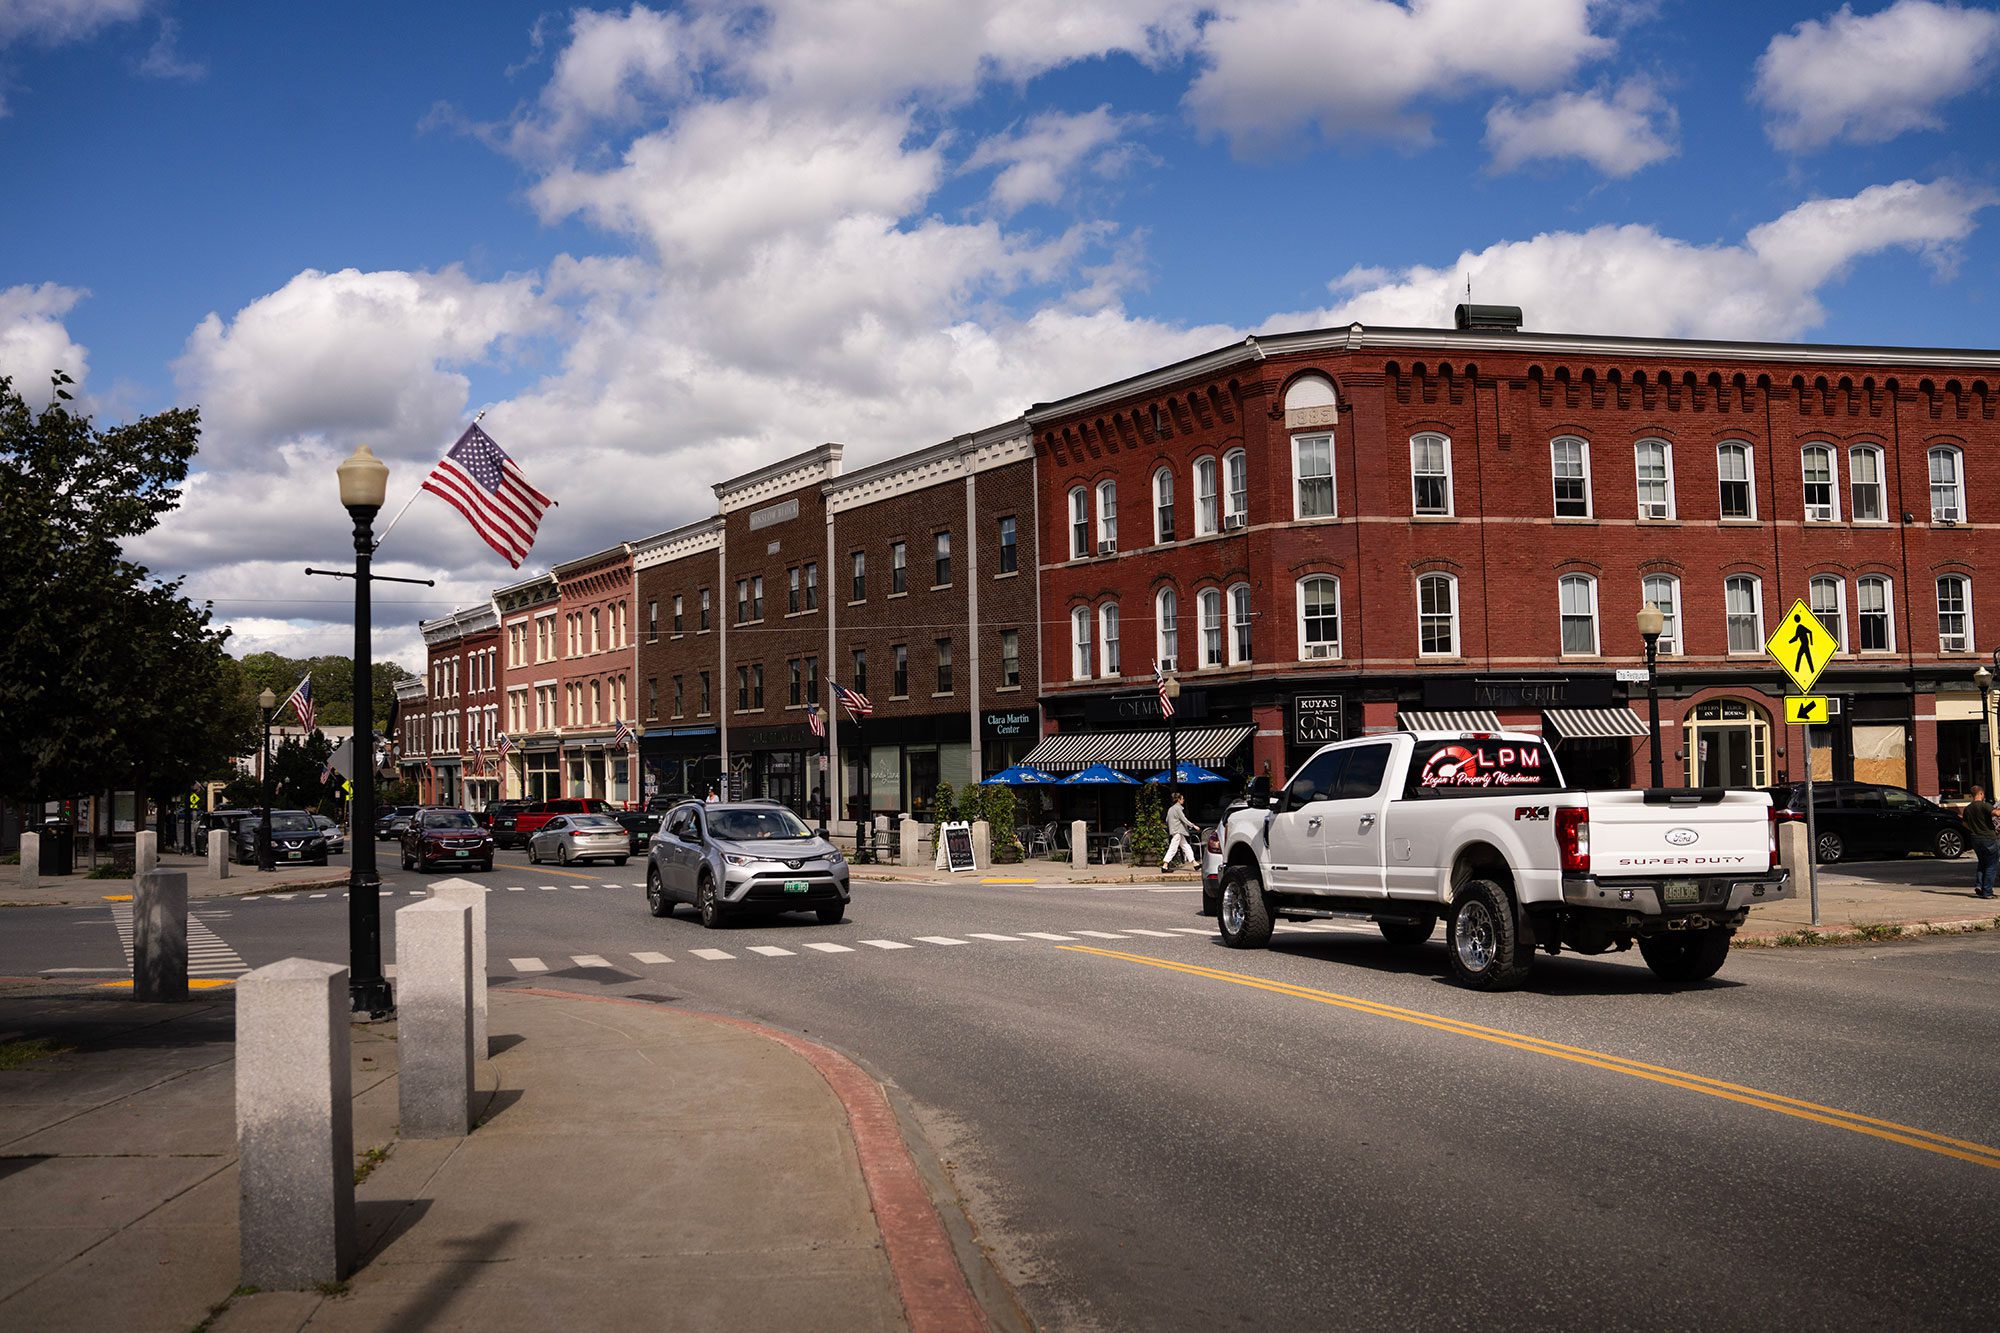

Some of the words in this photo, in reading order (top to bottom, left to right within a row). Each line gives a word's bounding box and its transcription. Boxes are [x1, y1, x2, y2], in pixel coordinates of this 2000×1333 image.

[1521, 685, 1567, 701] GRILL
[1301, 699, 1337, 709] KUYA'S
[987, 714, 1006, 725] Clara
[1006, 713, 1029, 724] Martin
[1300, 716, 1338, 728] ONE
[997, 725, 1020, 734] Center
[1300, 728, 1339, 739] MAIN
[1477, 747, 1540, 768] LPM
[1456, 771, 1491, 788] Property
[1492, 770, 1540, 785] Maintenance
[1514, 806, 1549, 820] FX4
[1673, 832, 1692, 842] Ford
[1619, 857, 1689, 865] SUPER
[1695, 856, 1745, 864] DUTY
